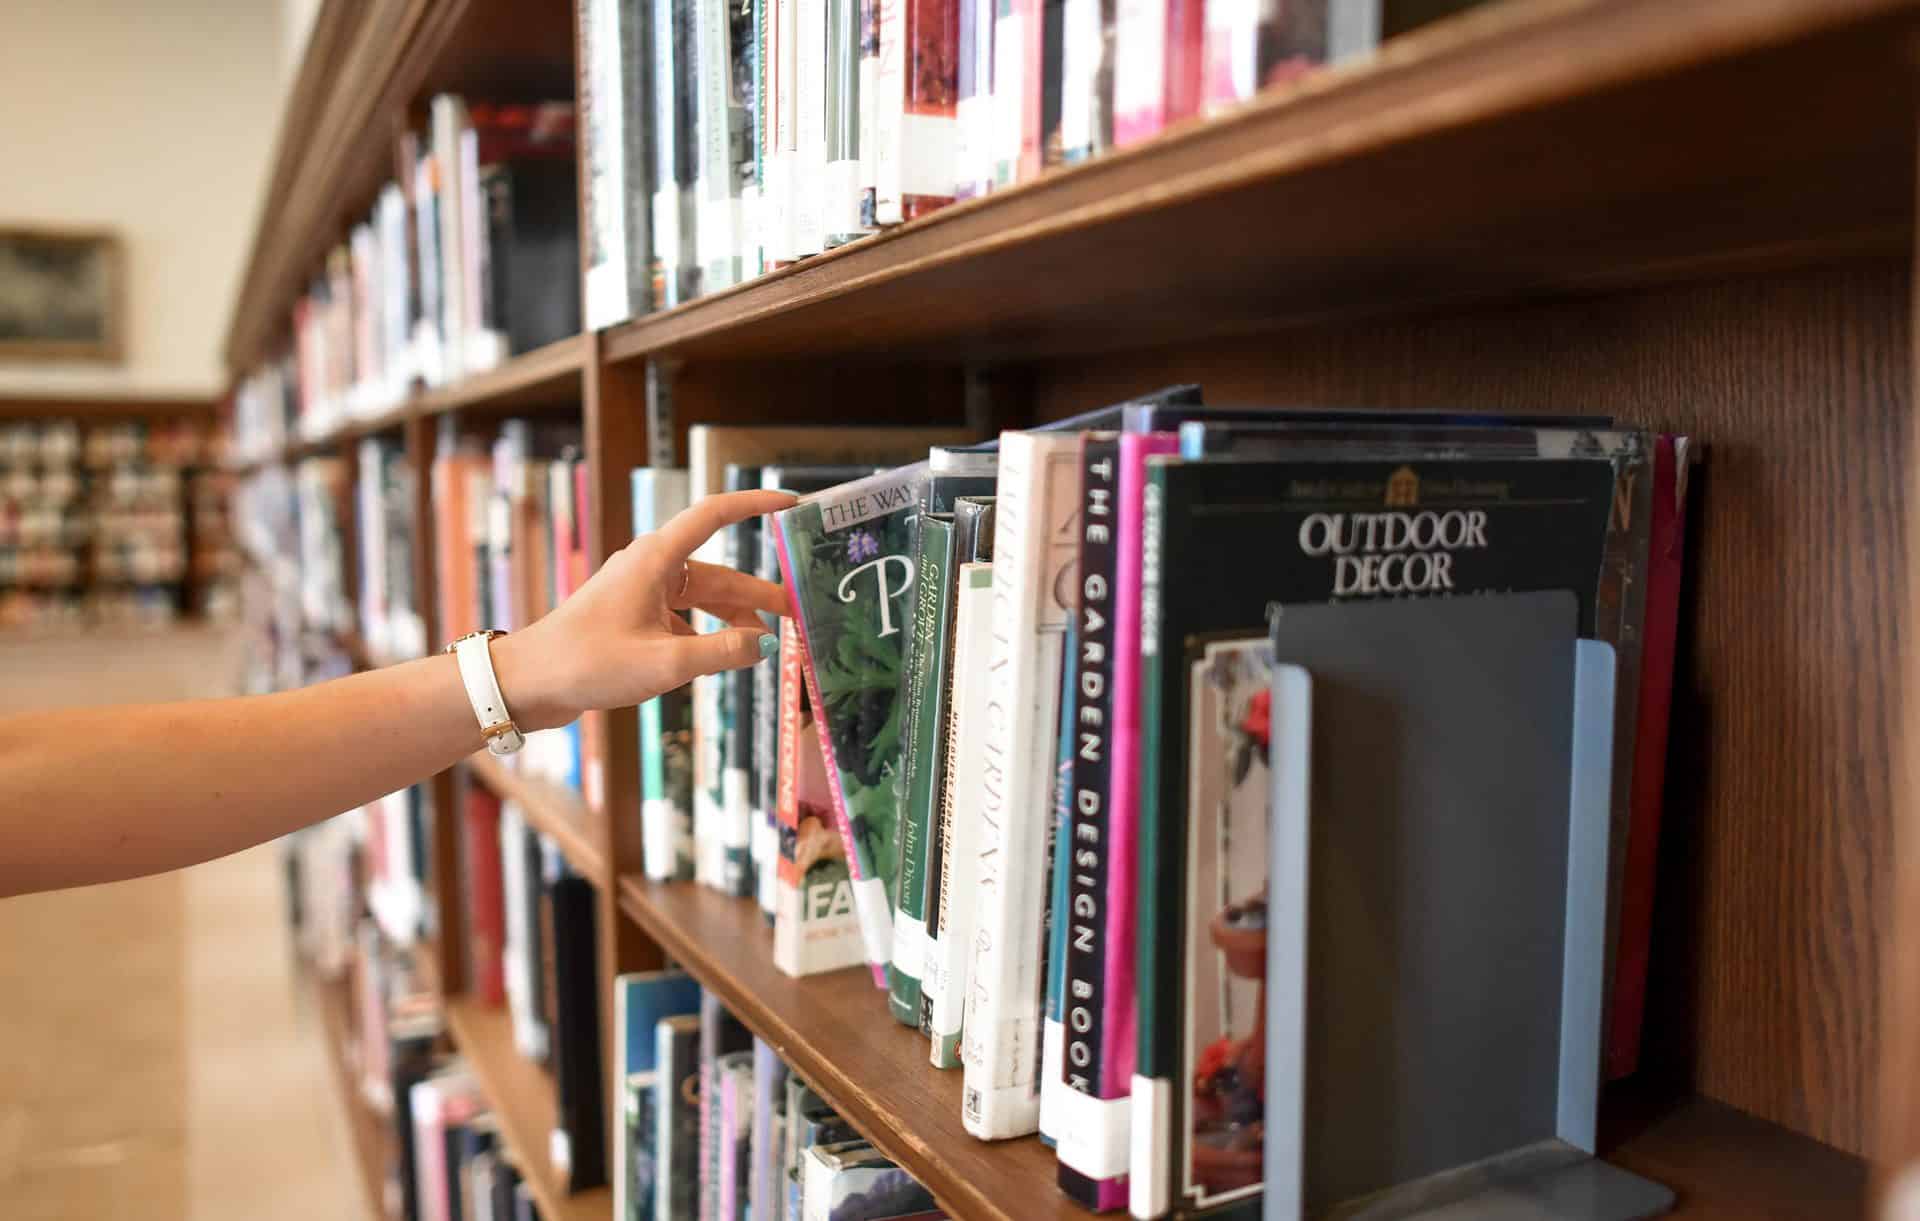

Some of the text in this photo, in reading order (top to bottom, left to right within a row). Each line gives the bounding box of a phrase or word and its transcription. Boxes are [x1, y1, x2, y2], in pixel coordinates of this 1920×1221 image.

[824, 497, 868, 526] THE
[1086, 457, 1112, 544] THE
[1299, 511, 1488, 557] OUTDOOR
[1333, 551, 1453, 595] DECOR
[915, 582, 929, 645] GROVE
[925, 563, 940, 641] GARDEN
[1080, 573, 1107, 761] GARDEN
[782, 681, 798, 814] GARDENS
[948, 711, 959, 787] MAKEOVERS
[946, 792, 954, 828] FROM
[904, 818, 918, 855] John
[943, 833, 951, 855] THE
[903, 857, 916, 905] Dixon
[940, 860, 950, 911] BUDGET
[1074, 789, 1099, 953] DESIGN
